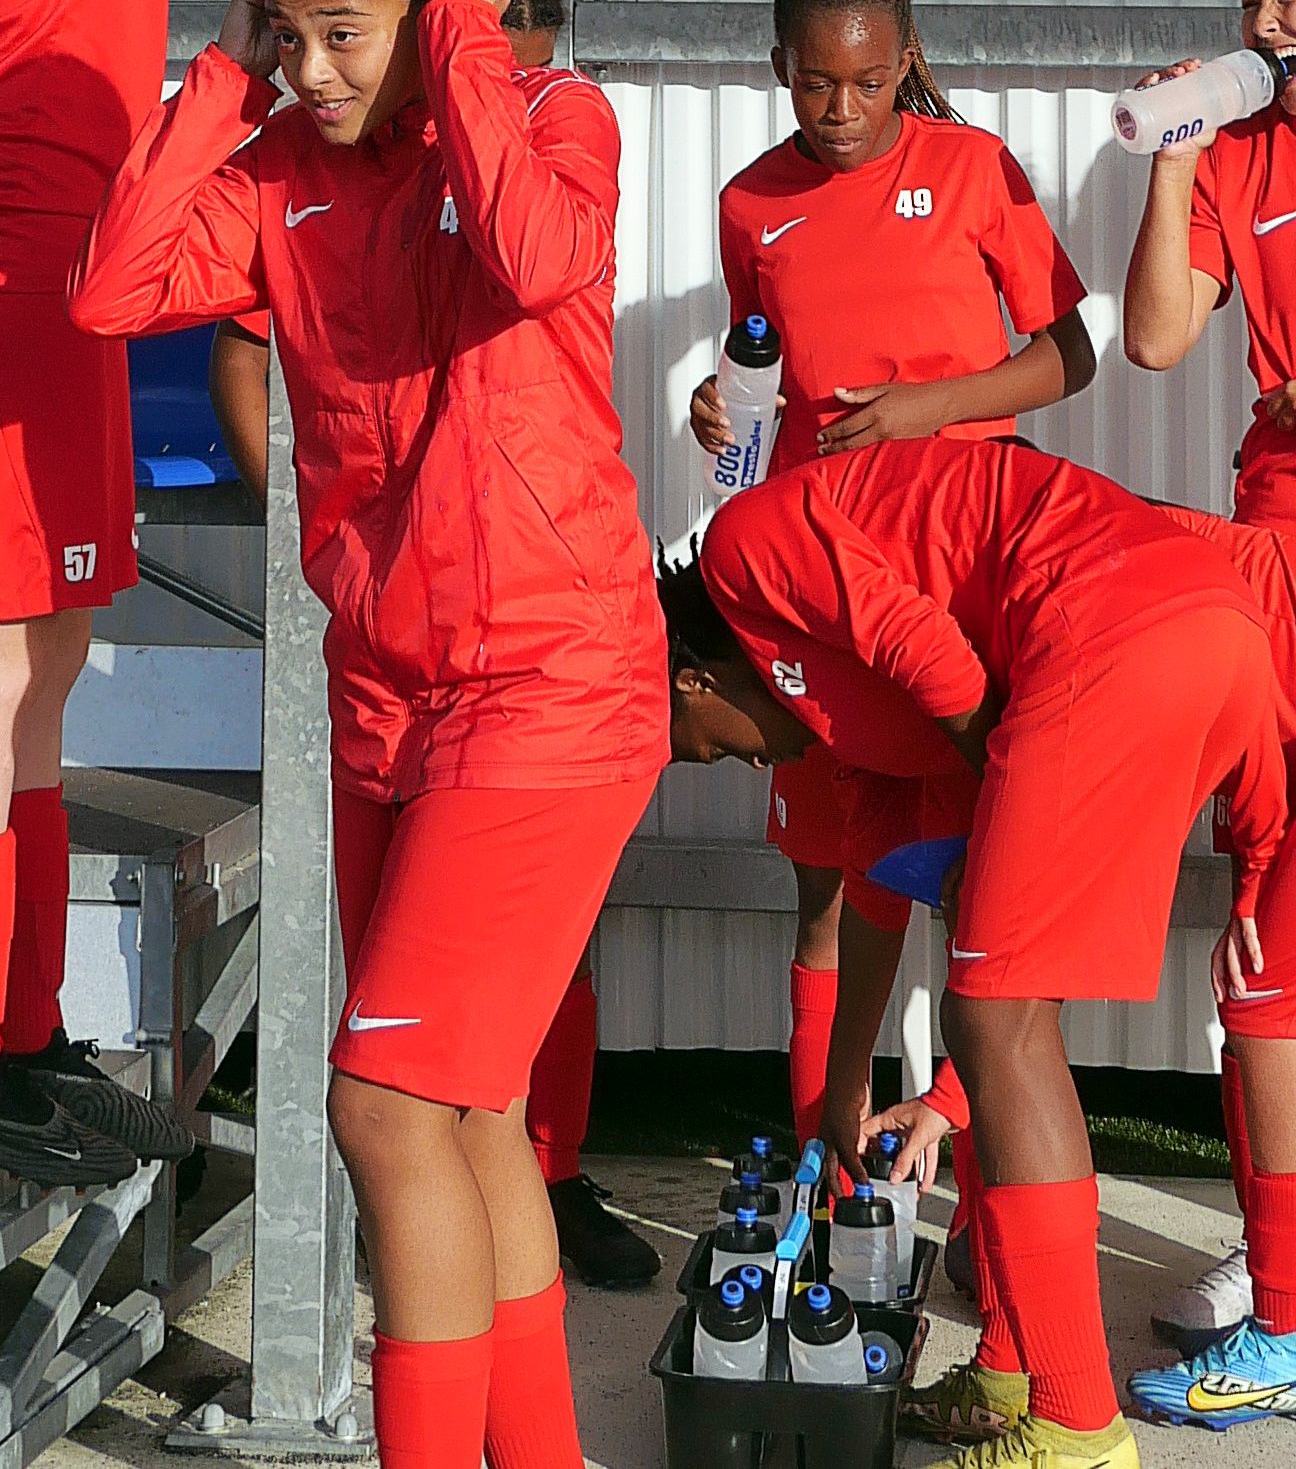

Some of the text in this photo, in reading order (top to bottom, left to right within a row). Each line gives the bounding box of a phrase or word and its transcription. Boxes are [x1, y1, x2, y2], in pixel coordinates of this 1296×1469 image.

[895, 187, 933, 218] 49
[64, 542, 97, 582] 57
[771, 659, 807, 696] 62
